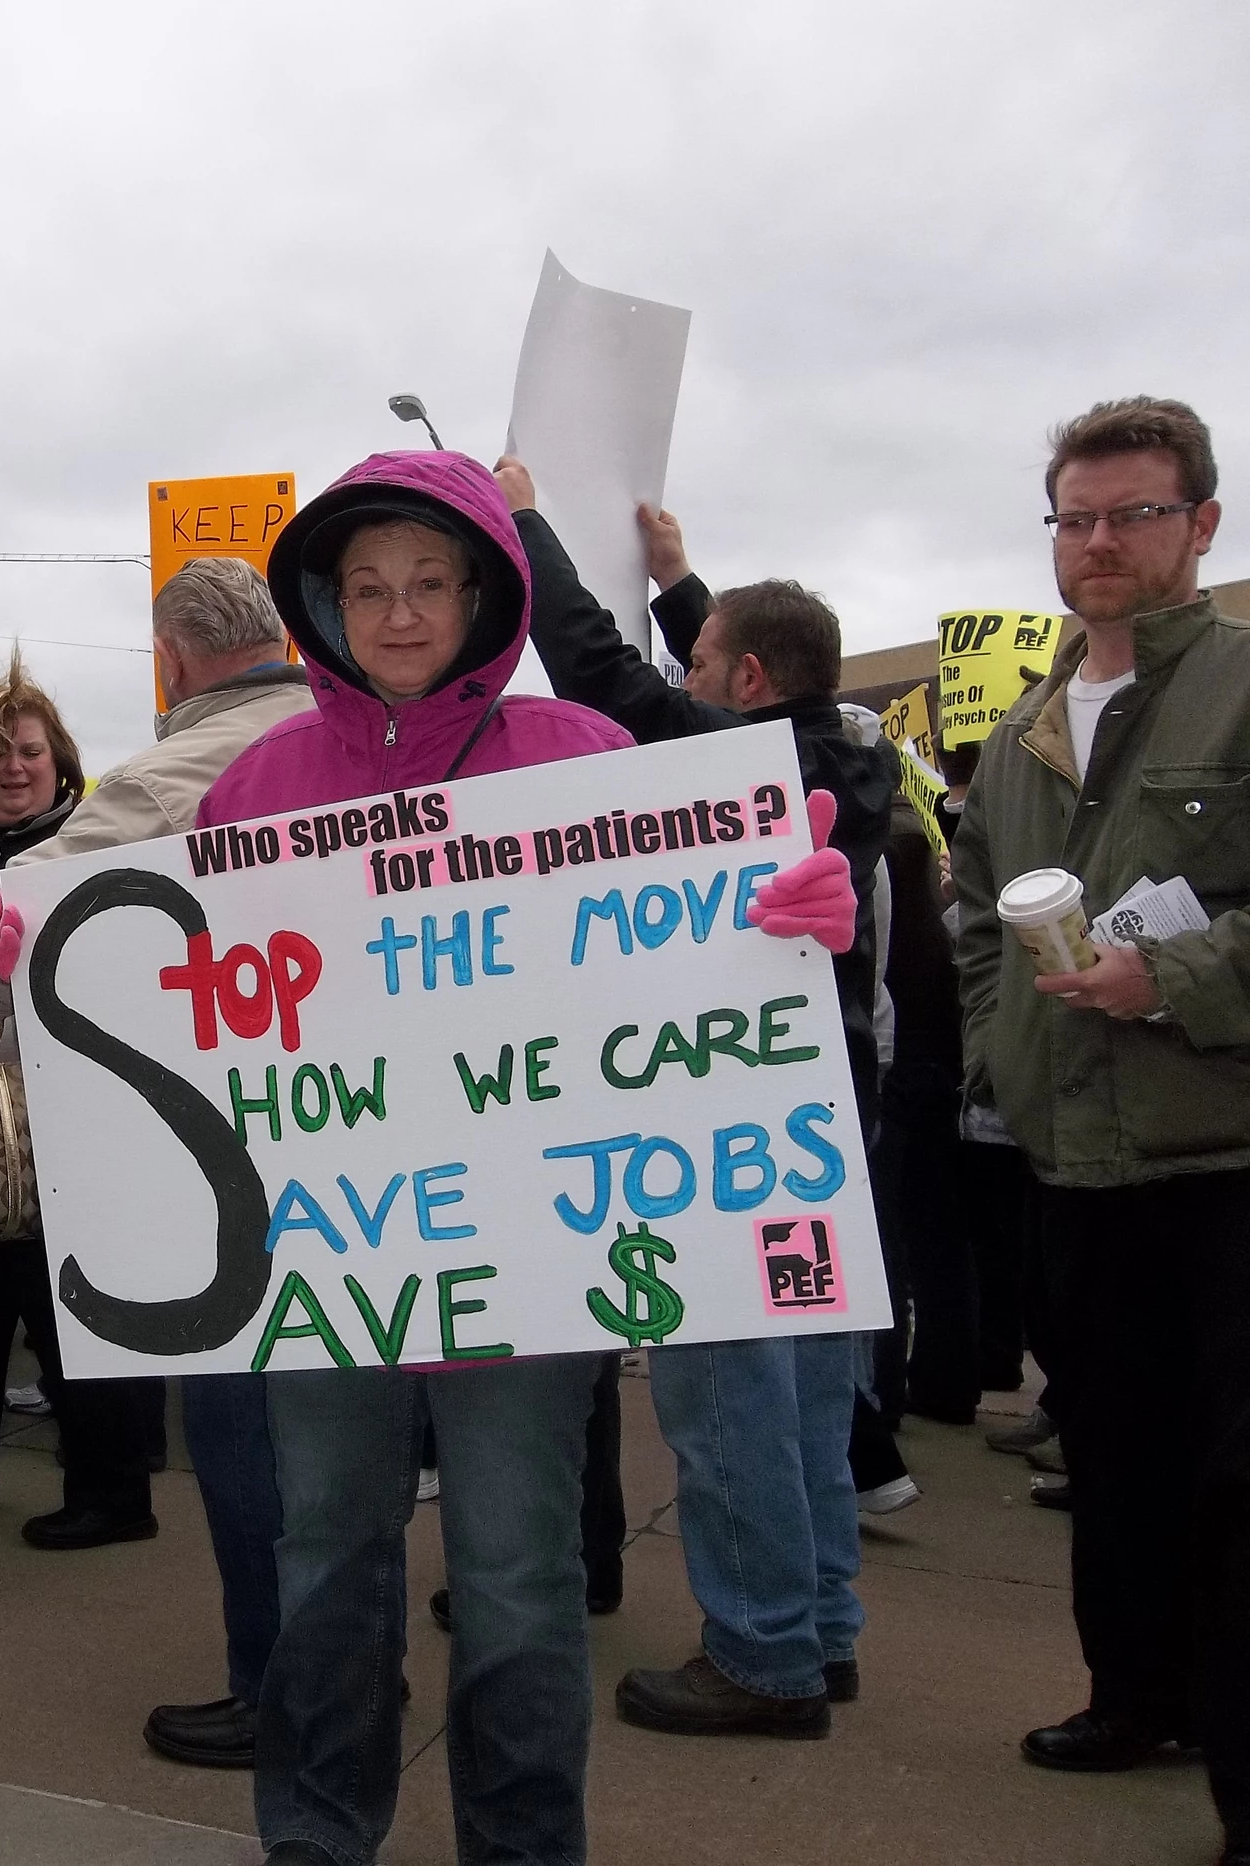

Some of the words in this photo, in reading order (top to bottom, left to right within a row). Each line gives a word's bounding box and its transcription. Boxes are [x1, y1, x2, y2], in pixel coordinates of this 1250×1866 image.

[171, 503, 284, 543] KEEP
[938, 614, 1004, 656] TOP
[1014, 632, 1048, 648] PEF
[942, 665, 961, 683] The
[968, 685, 984, 703] Of
[953, 709, 986, 727] Psych
[186, 816, 281, 878] Who
[288, 791, 449, 859] speaks
[370, 849, 435, 895] for
[443, 834, 524, 883] the
[533, 799, 745, 876] patients
[570, 862, 779, 967] MOVE
[452, 1034, 561, 1114] WE
[600, 994, 821, 1090] CARE
[542, 1102, 847, 1236] JOBS
[586, 1220, 686, 1347] $
[768, 1262, 835, 1300] PEF
